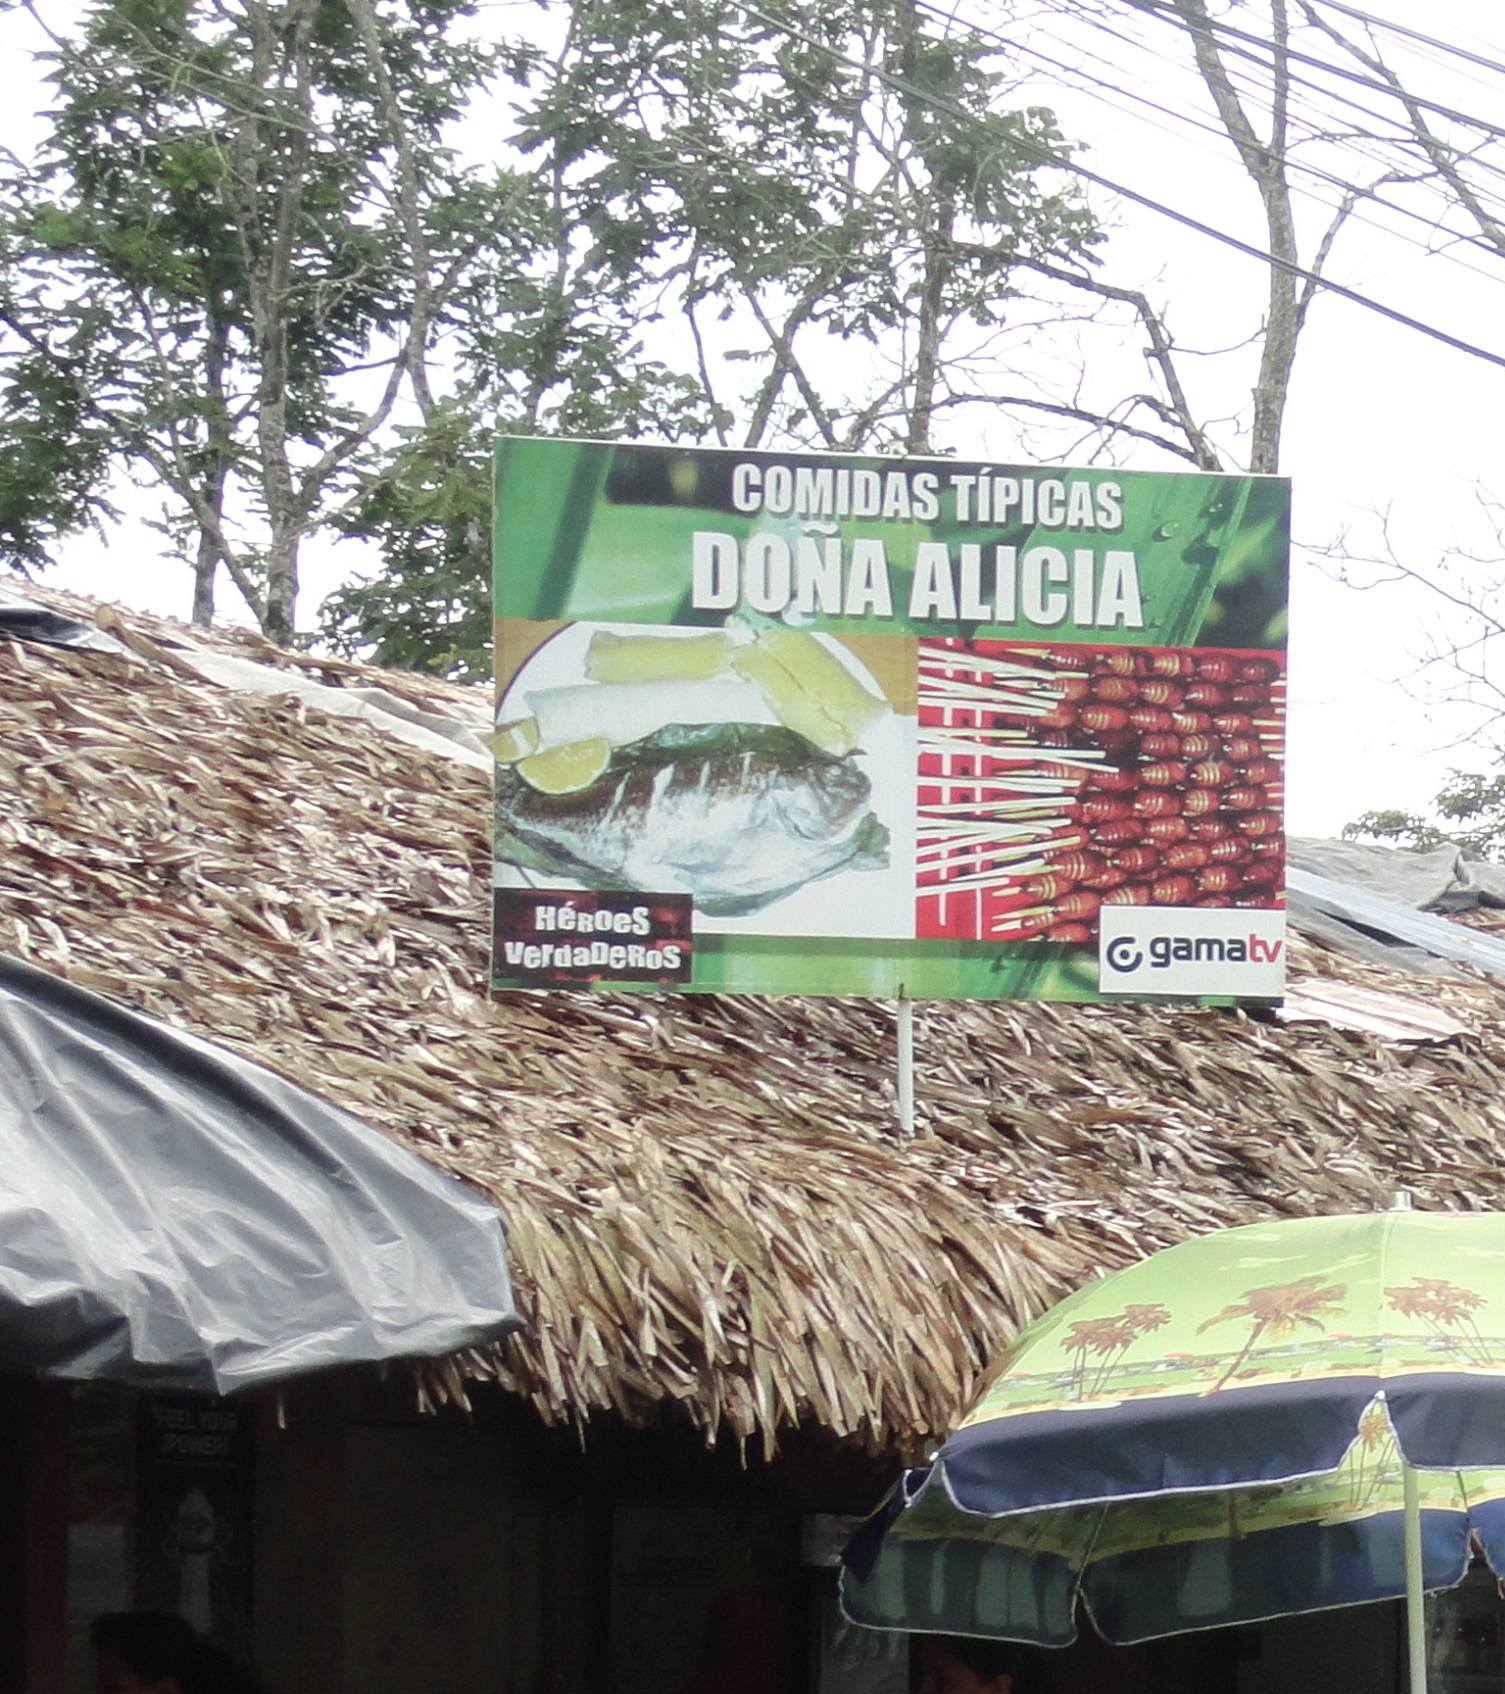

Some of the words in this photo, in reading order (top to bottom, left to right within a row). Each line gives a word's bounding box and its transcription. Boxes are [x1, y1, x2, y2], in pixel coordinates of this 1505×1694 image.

[732, 461, 940, 520] COMIDAS
[950, 467, 1125, 530] TÍPICAS
[691, 520, 894, 617] DOÑA
[908, 541, 1145, 628] ALICIA
